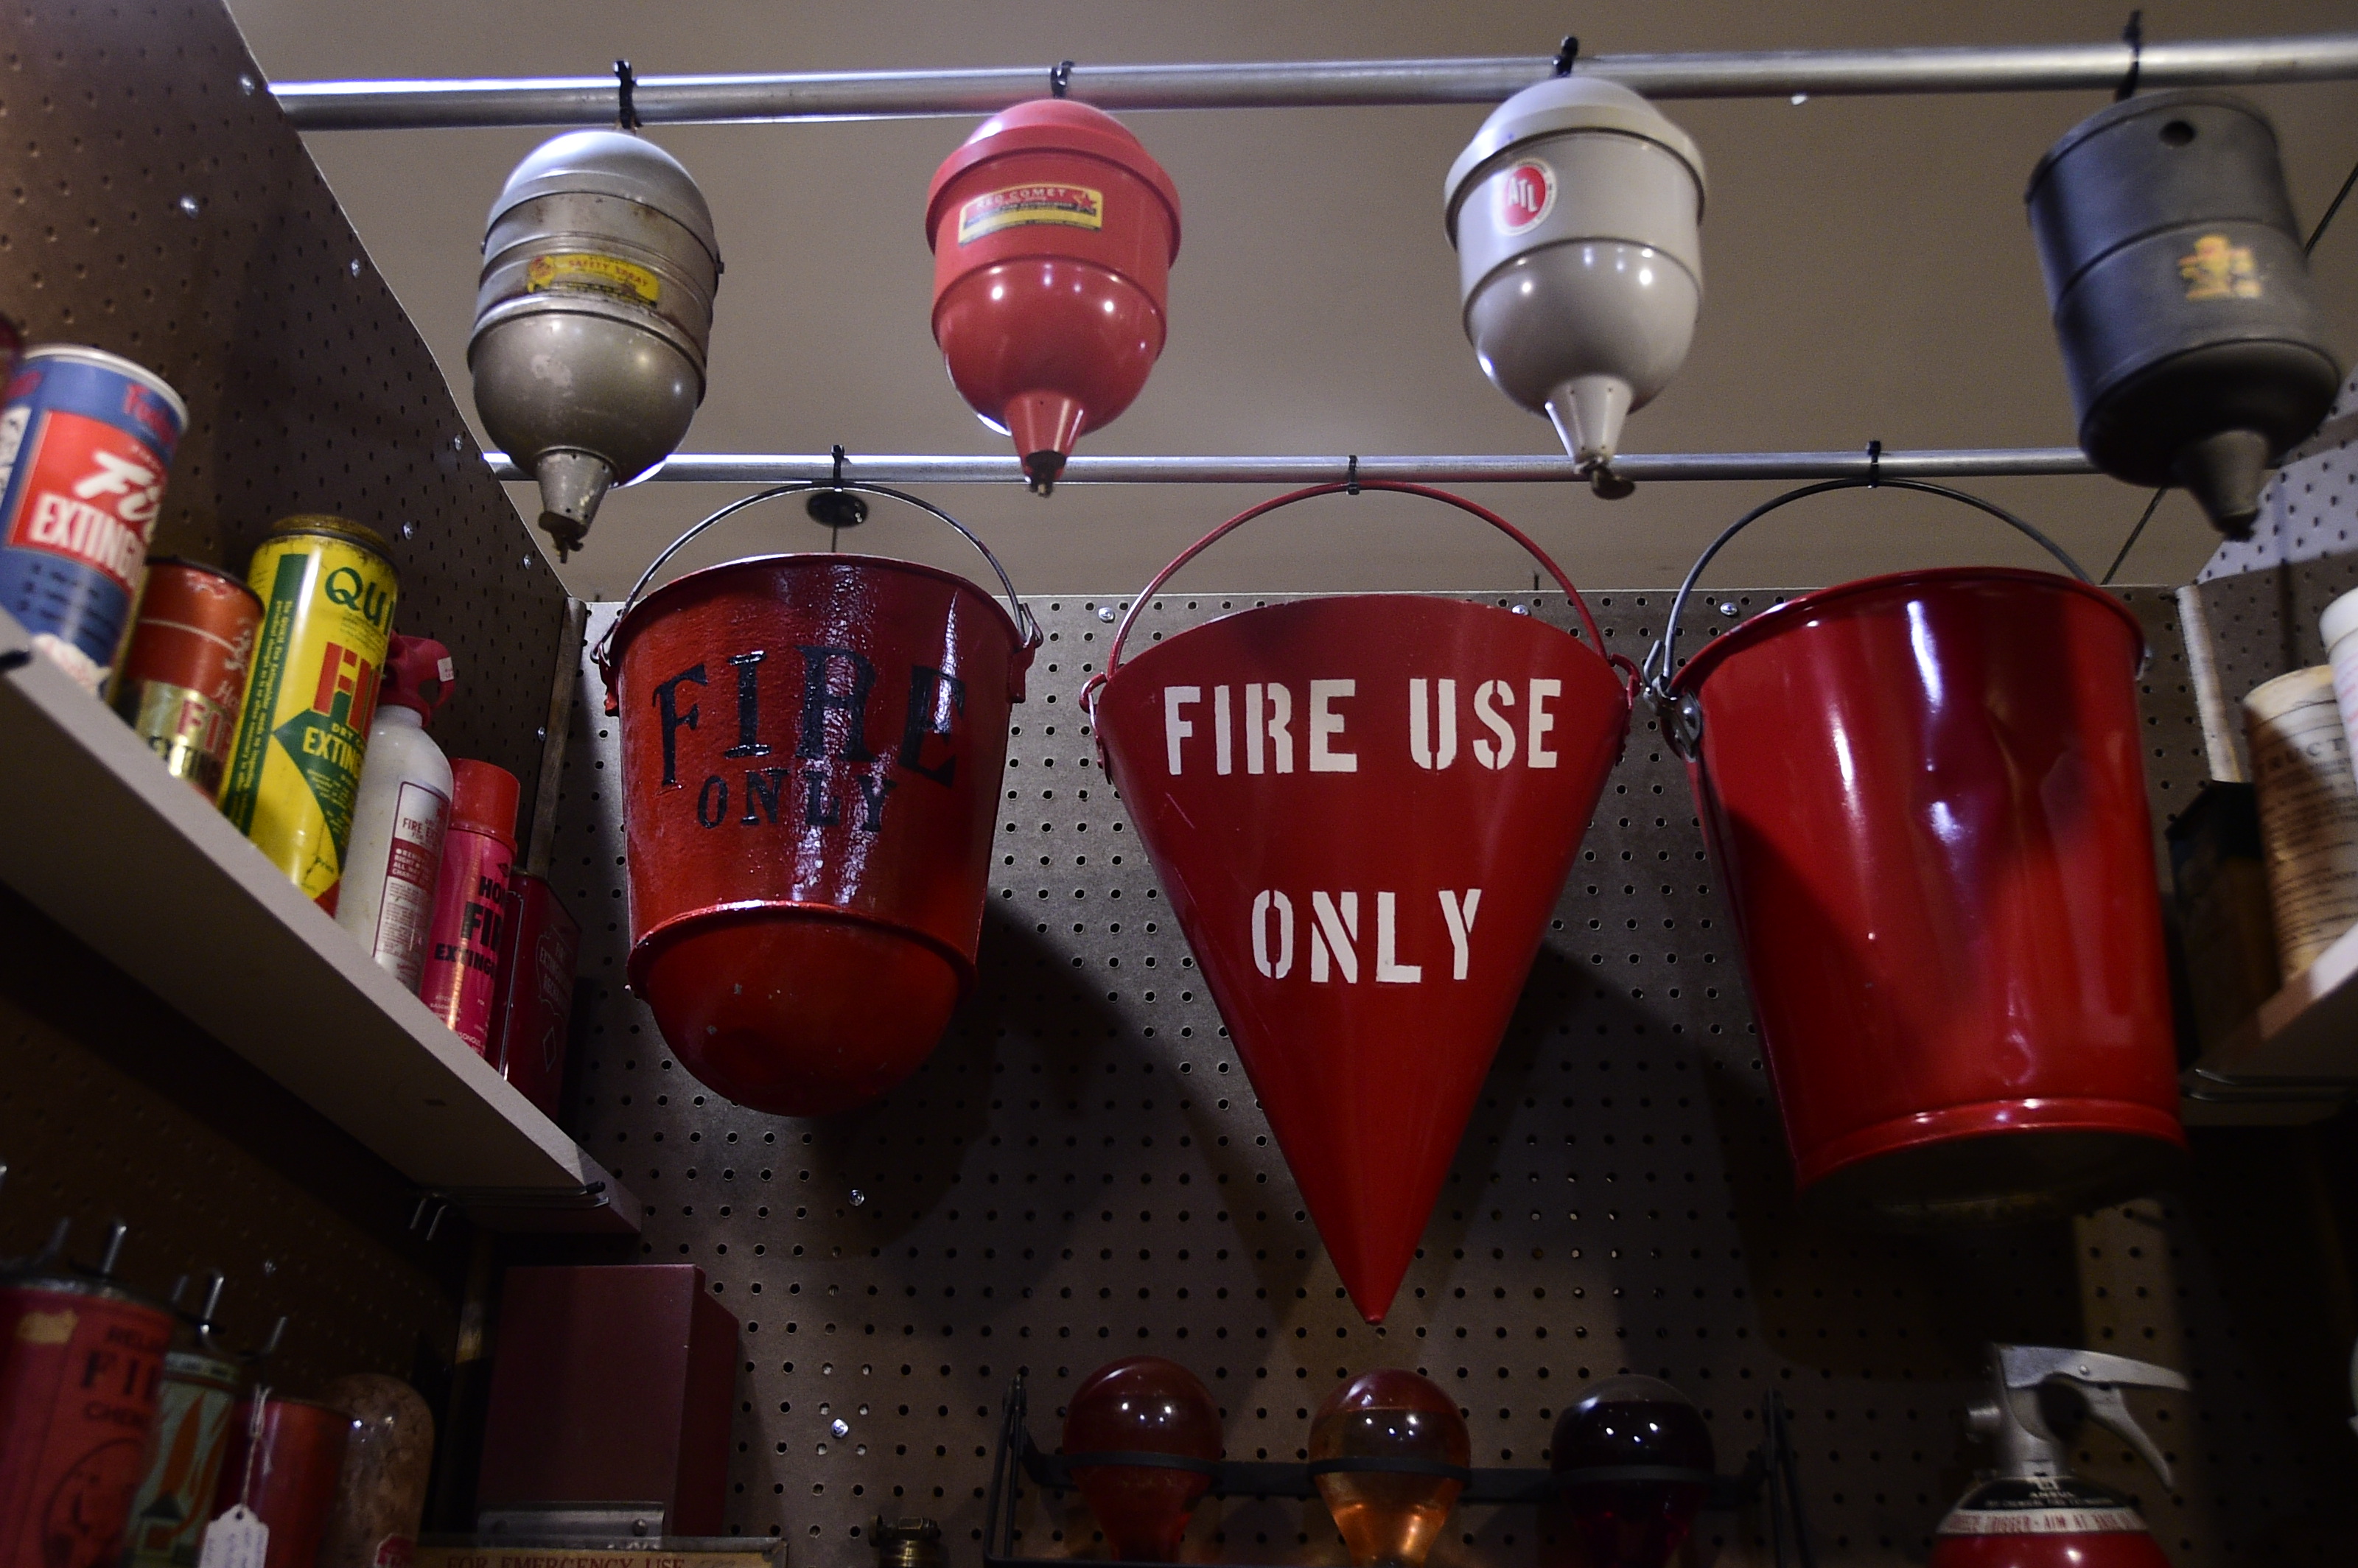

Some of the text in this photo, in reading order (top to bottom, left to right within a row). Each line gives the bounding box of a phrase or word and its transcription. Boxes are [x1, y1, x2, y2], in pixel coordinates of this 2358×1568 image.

[1009, 187, 1067, 203] COMET
[651, 643, 967, 797] FIRE
[1164, 677, 1562, 776] FIRE USE
[696, 767, 898, 832] ONLY
[1251, 888, 1483, 984] ONLY
